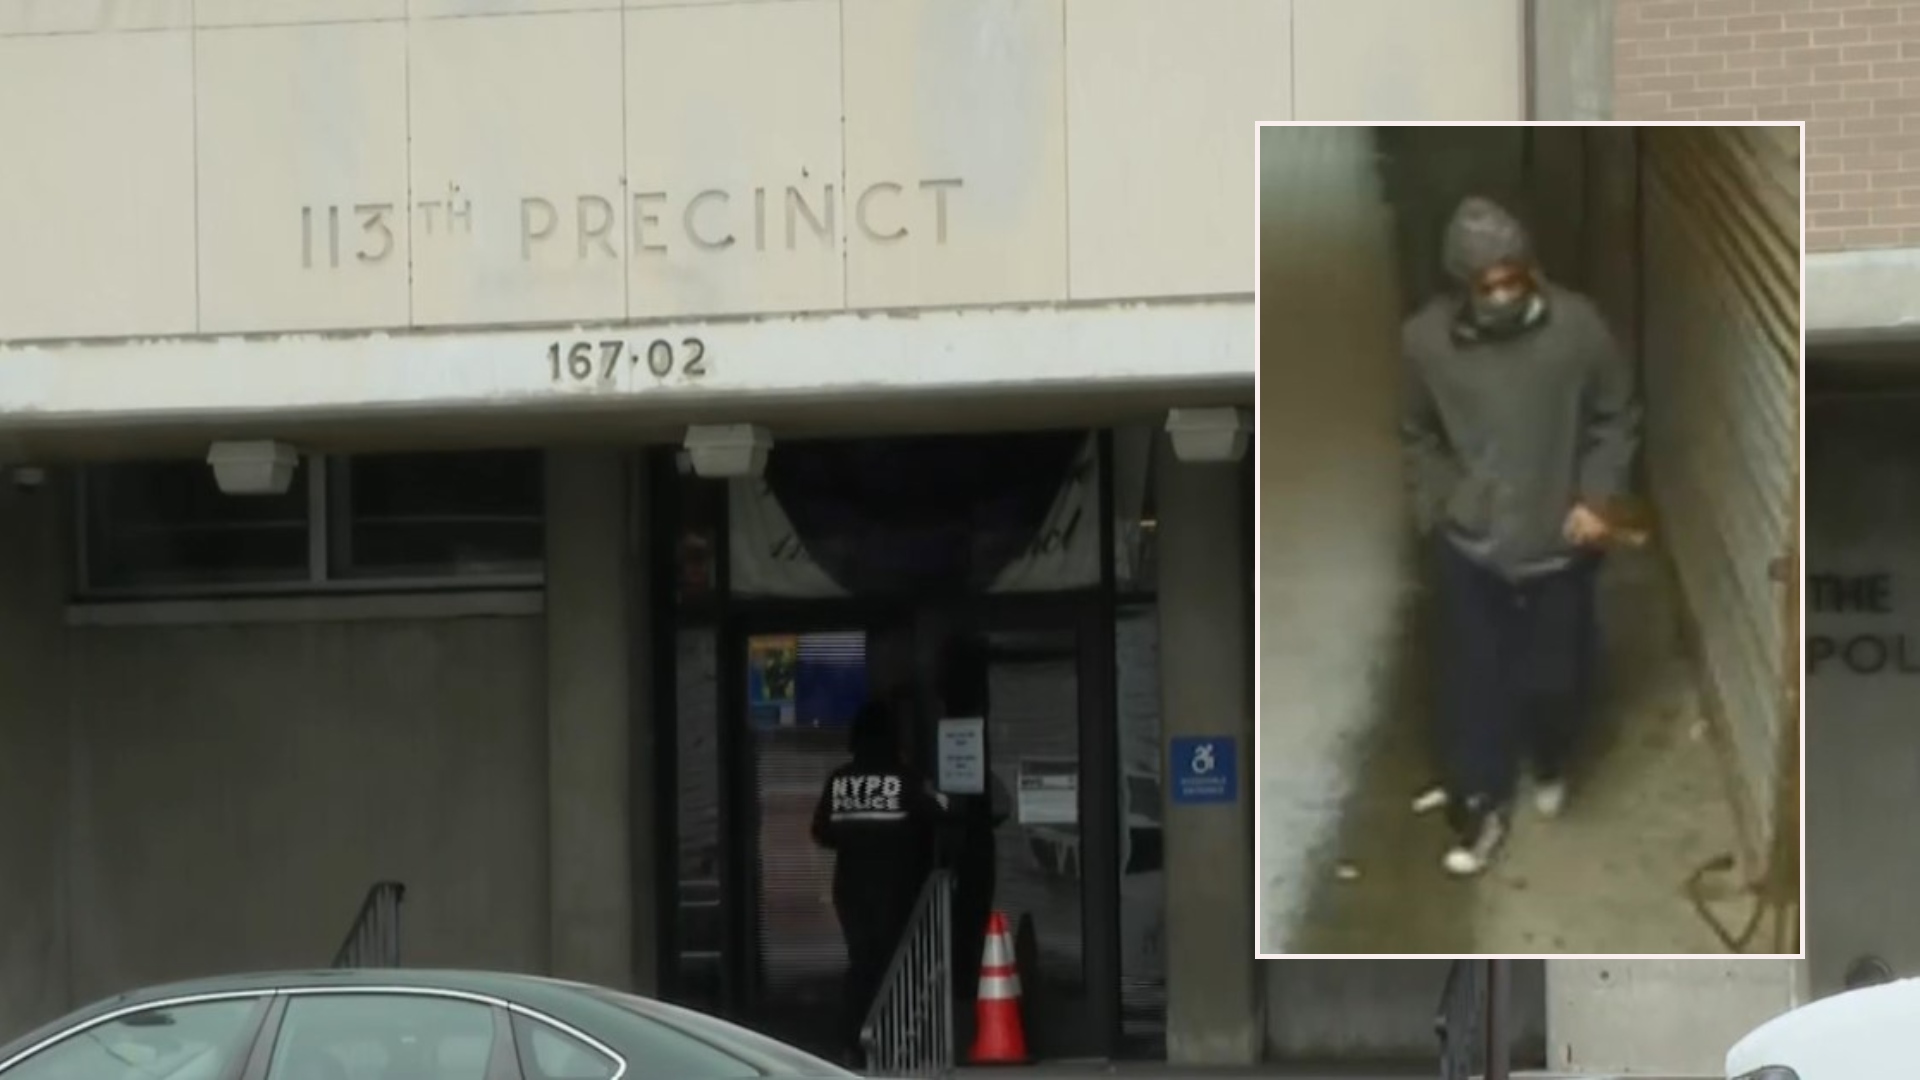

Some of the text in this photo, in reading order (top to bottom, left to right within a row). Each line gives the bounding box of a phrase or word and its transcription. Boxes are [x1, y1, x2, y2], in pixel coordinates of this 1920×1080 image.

[520, 178, 964, 260] PRECINCT
[1807, 573, 1893, 614] THE
[832, 775, 902, 797] NYPD
[832, 796, 901, 811] POLICE
